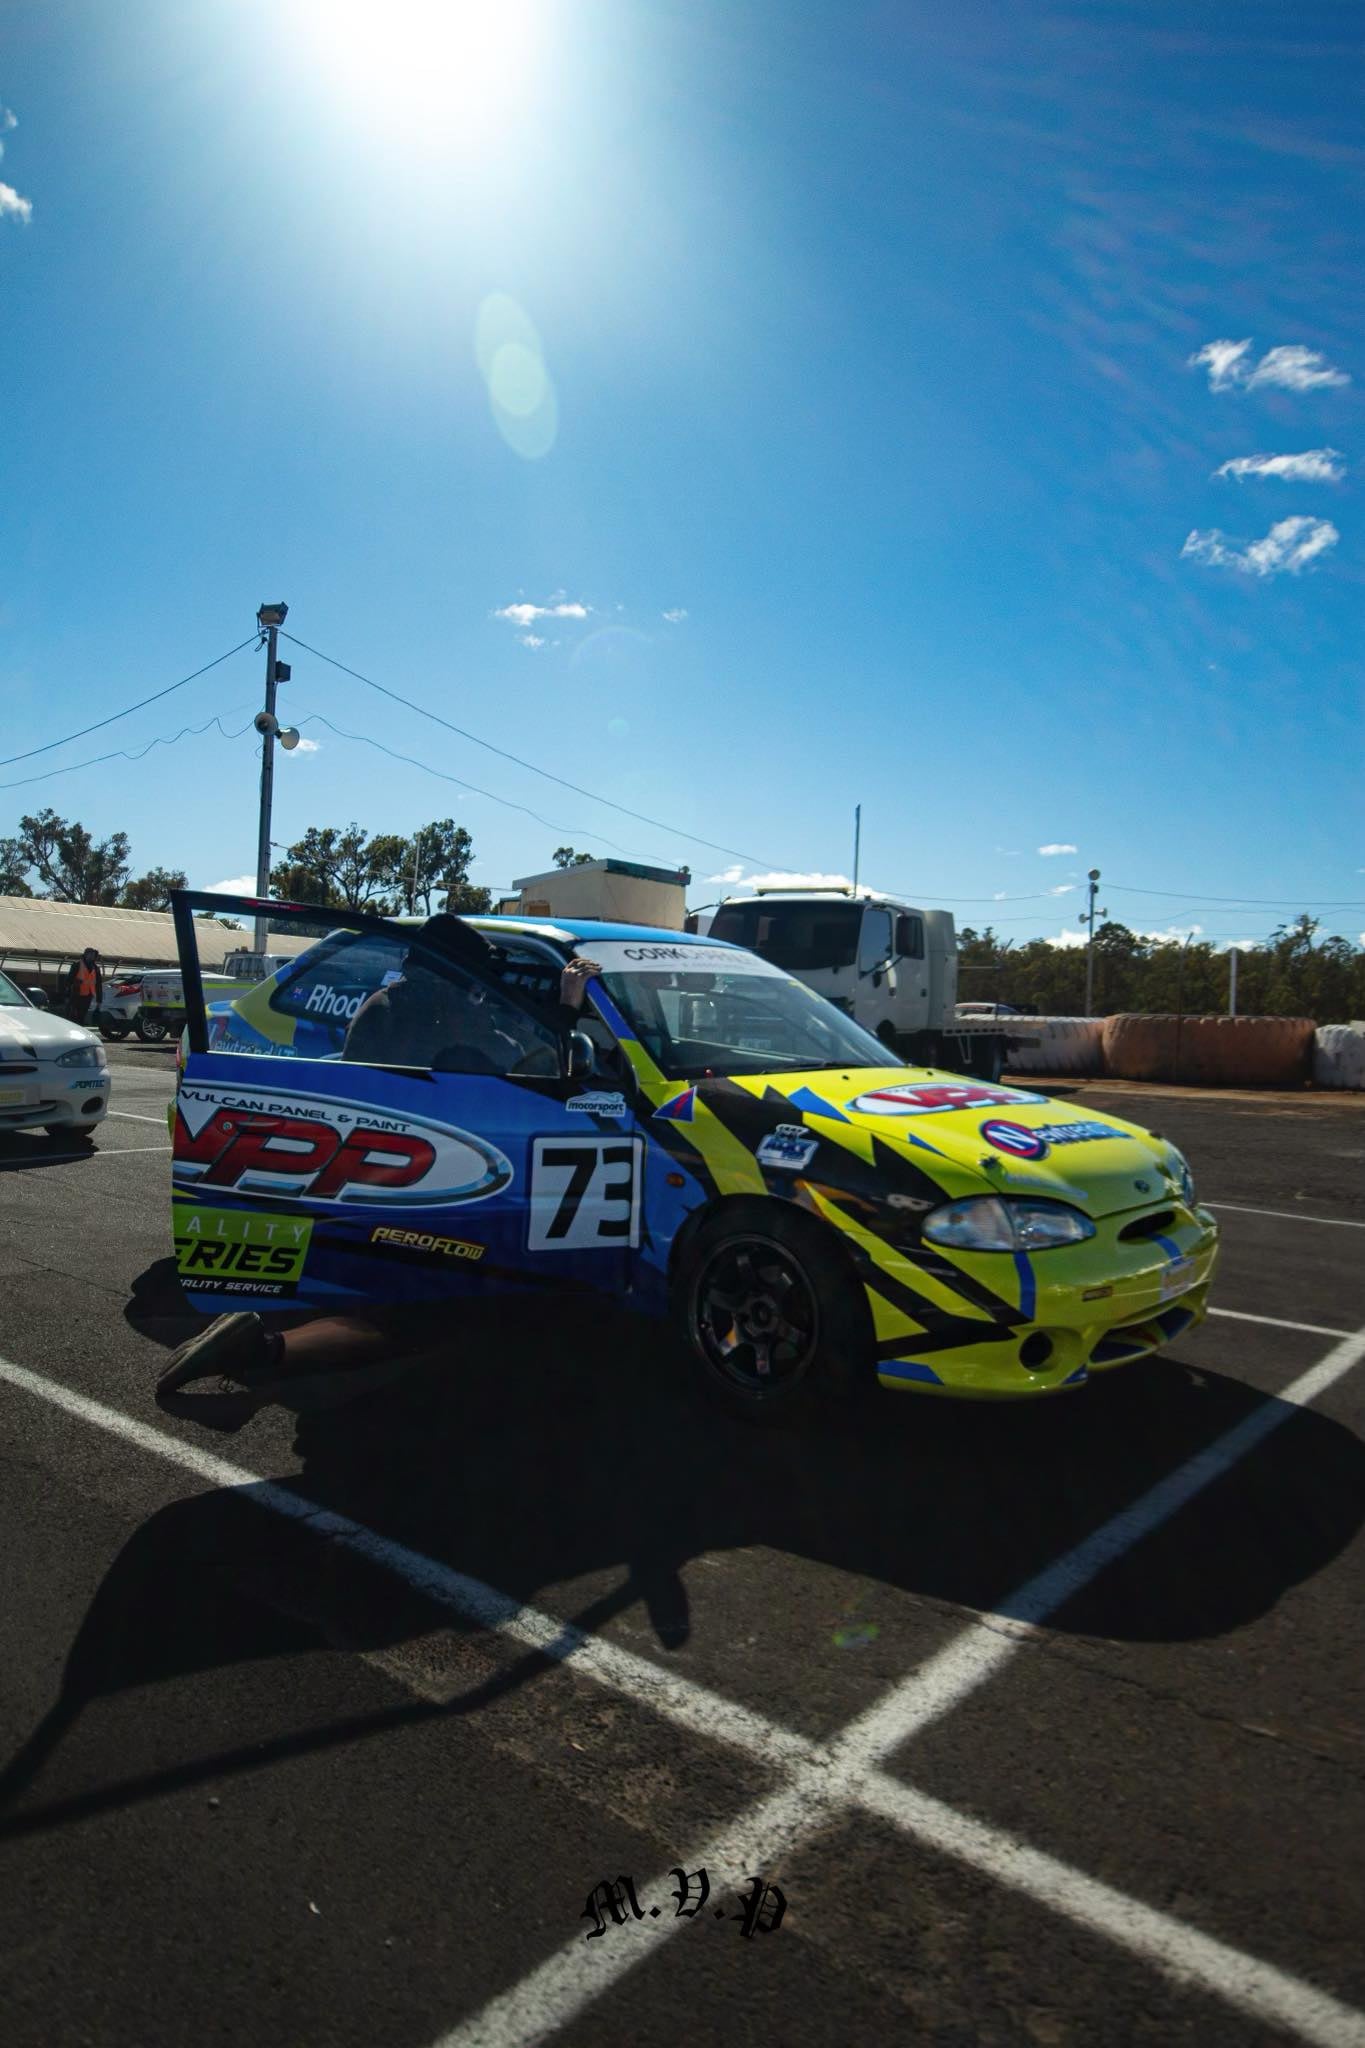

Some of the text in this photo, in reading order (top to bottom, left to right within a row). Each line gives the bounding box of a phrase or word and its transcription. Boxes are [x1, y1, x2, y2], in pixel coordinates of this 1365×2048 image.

[179, 1089, 411, 1132] VULCAN PANEL & PAINT
[542, 1147, 634, 1240] 73
[185, 1215, 306, 1243] ALITY
[371, 1226, 486, 1261] AEROFLOW
[181, 1279, 283, 1294] ALITY SERVICE
